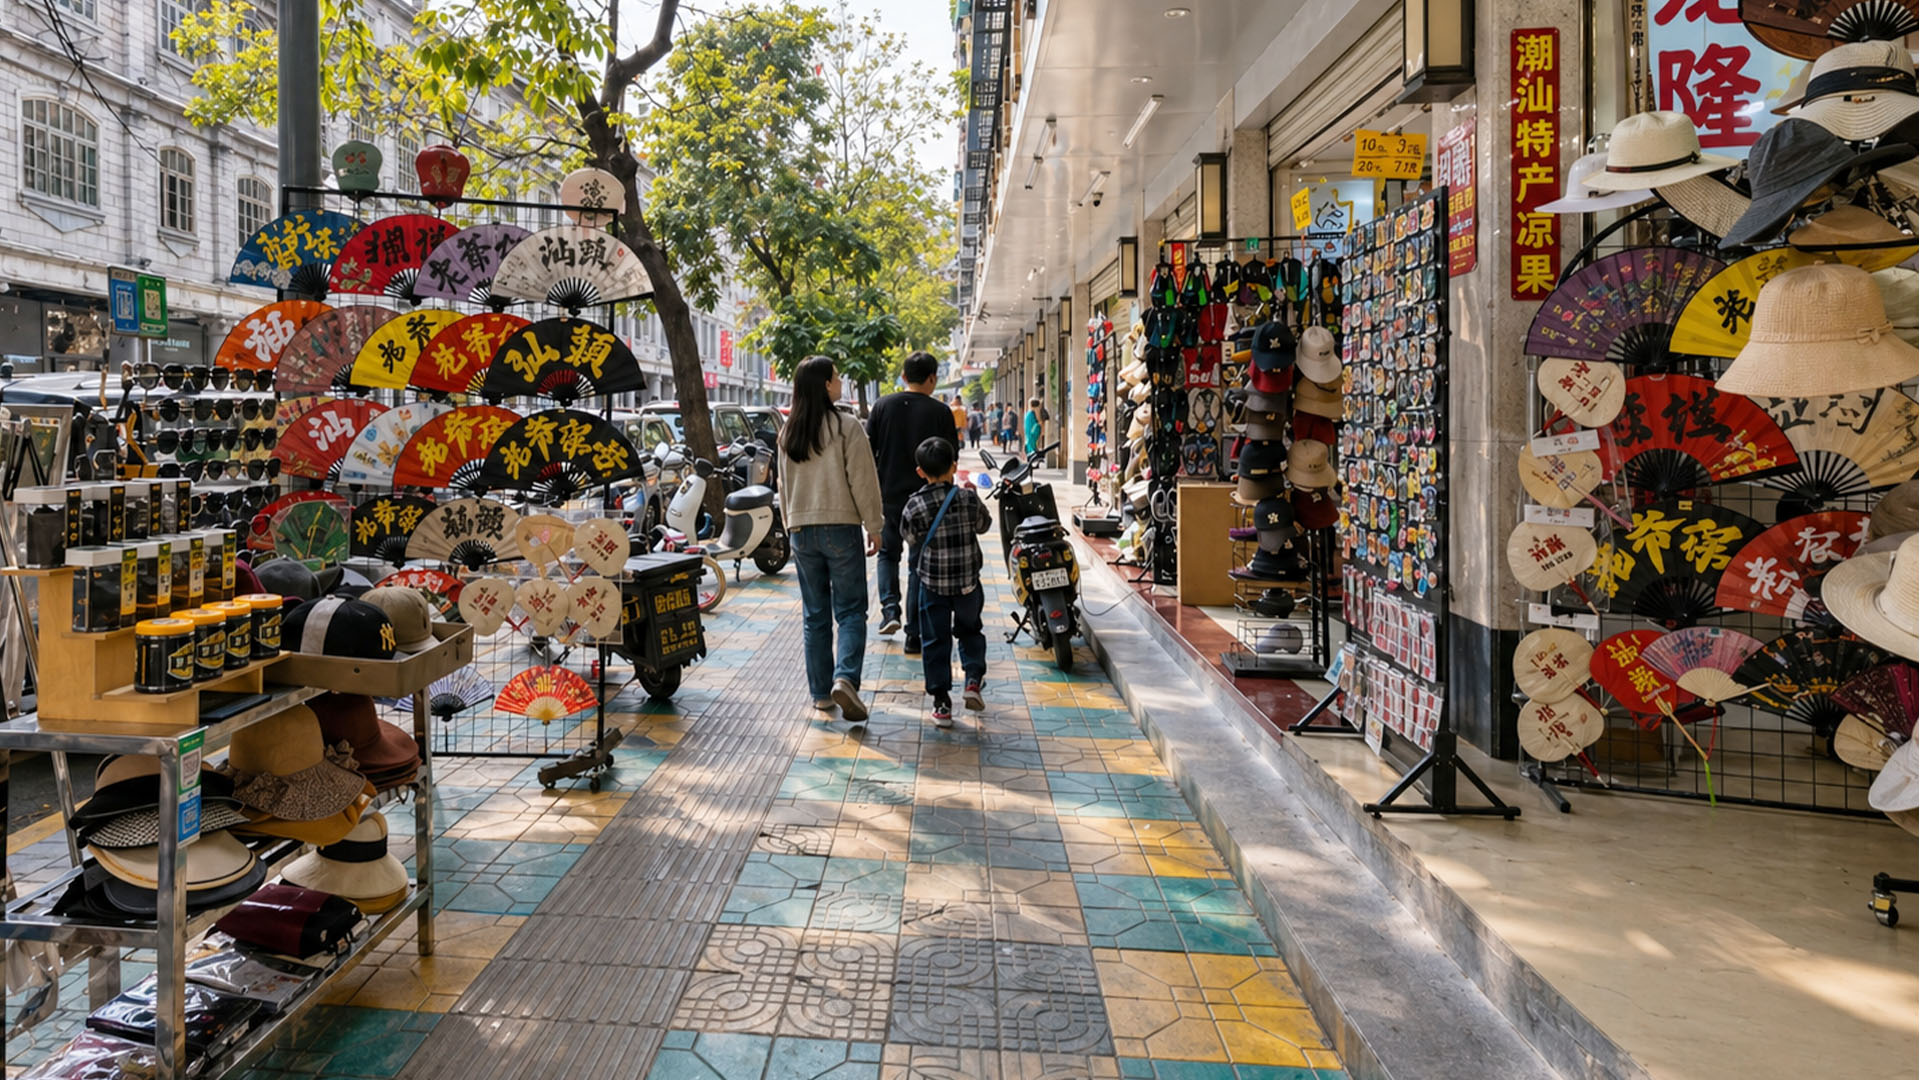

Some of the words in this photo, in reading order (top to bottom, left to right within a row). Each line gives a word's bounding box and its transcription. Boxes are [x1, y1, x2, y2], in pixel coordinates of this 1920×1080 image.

[1516, 34, 1555, 294] 潮汕特产凉果
[1654, 0, 1762, 148] 隆
